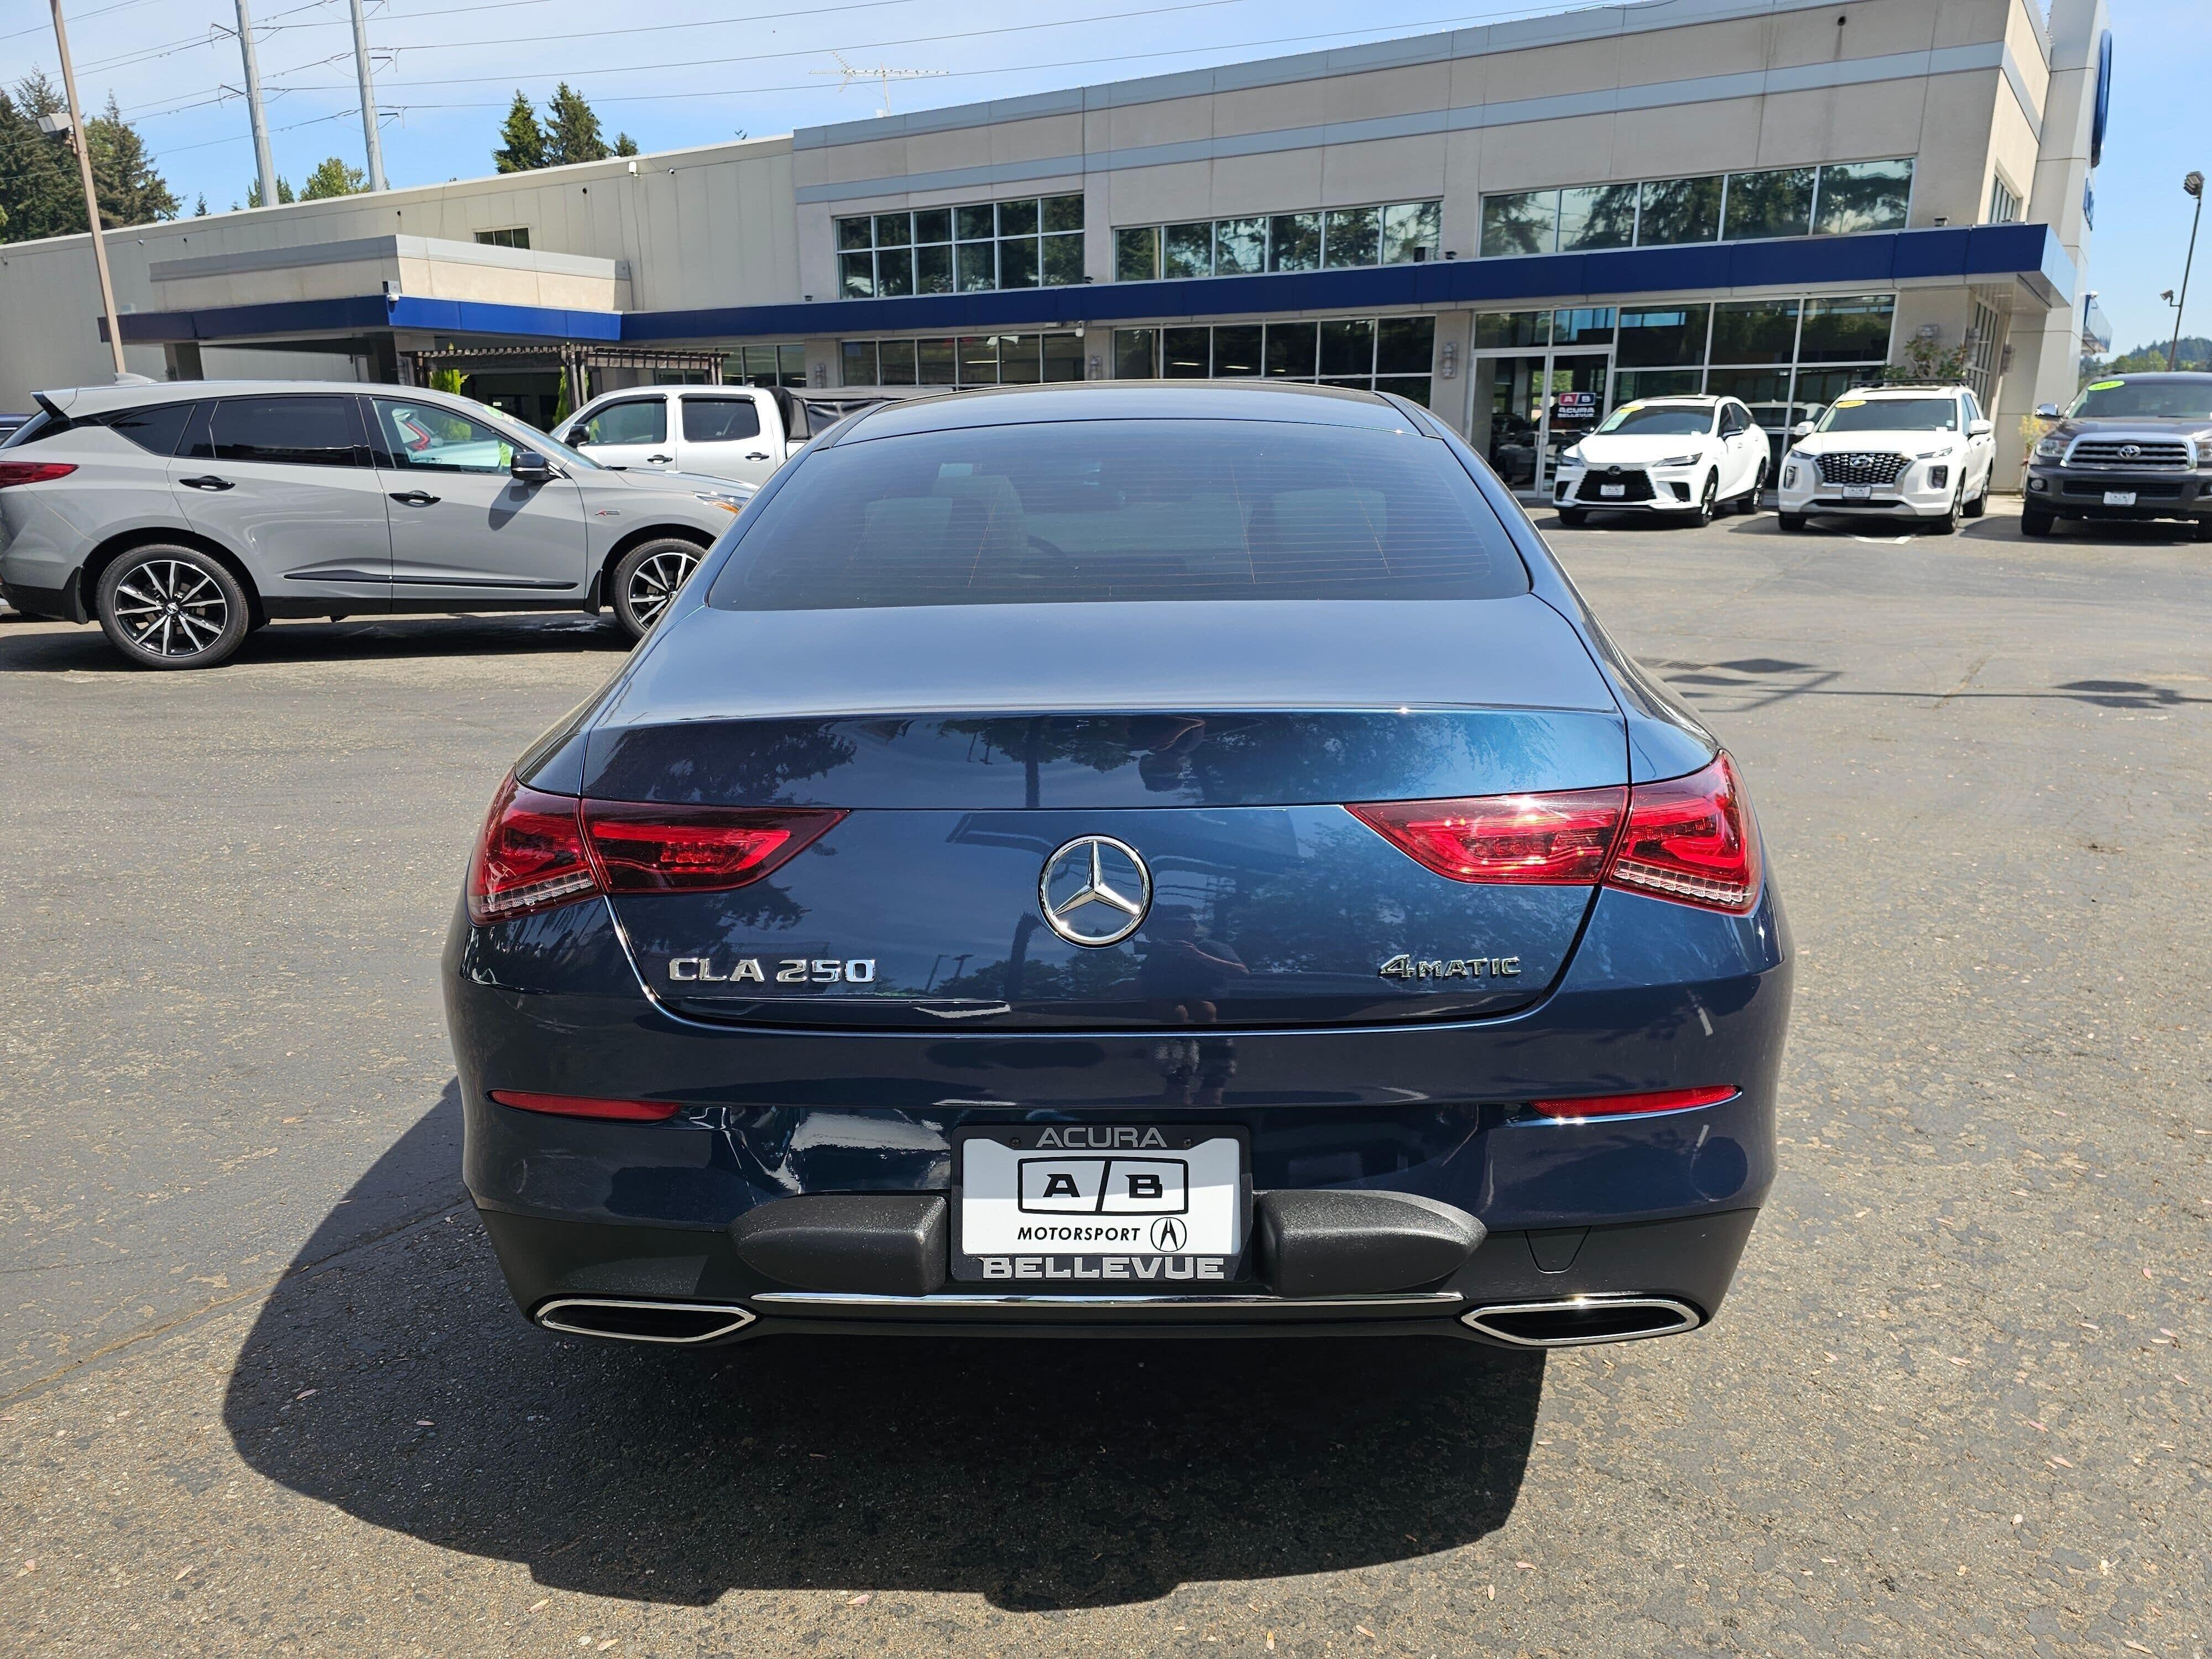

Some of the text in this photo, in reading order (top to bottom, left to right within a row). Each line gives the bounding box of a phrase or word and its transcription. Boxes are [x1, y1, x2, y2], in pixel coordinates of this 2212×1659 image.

[669, 958, 876, 983] CLA 250
[1380, 954, 1521, 978] 4MATIC
[1035, 1127, 1167, 1148] ACURA
[1018, 1226, 1141, 1241] MOTORSPORT
[979, 1256, 1225, 1280] BELLEVUE
